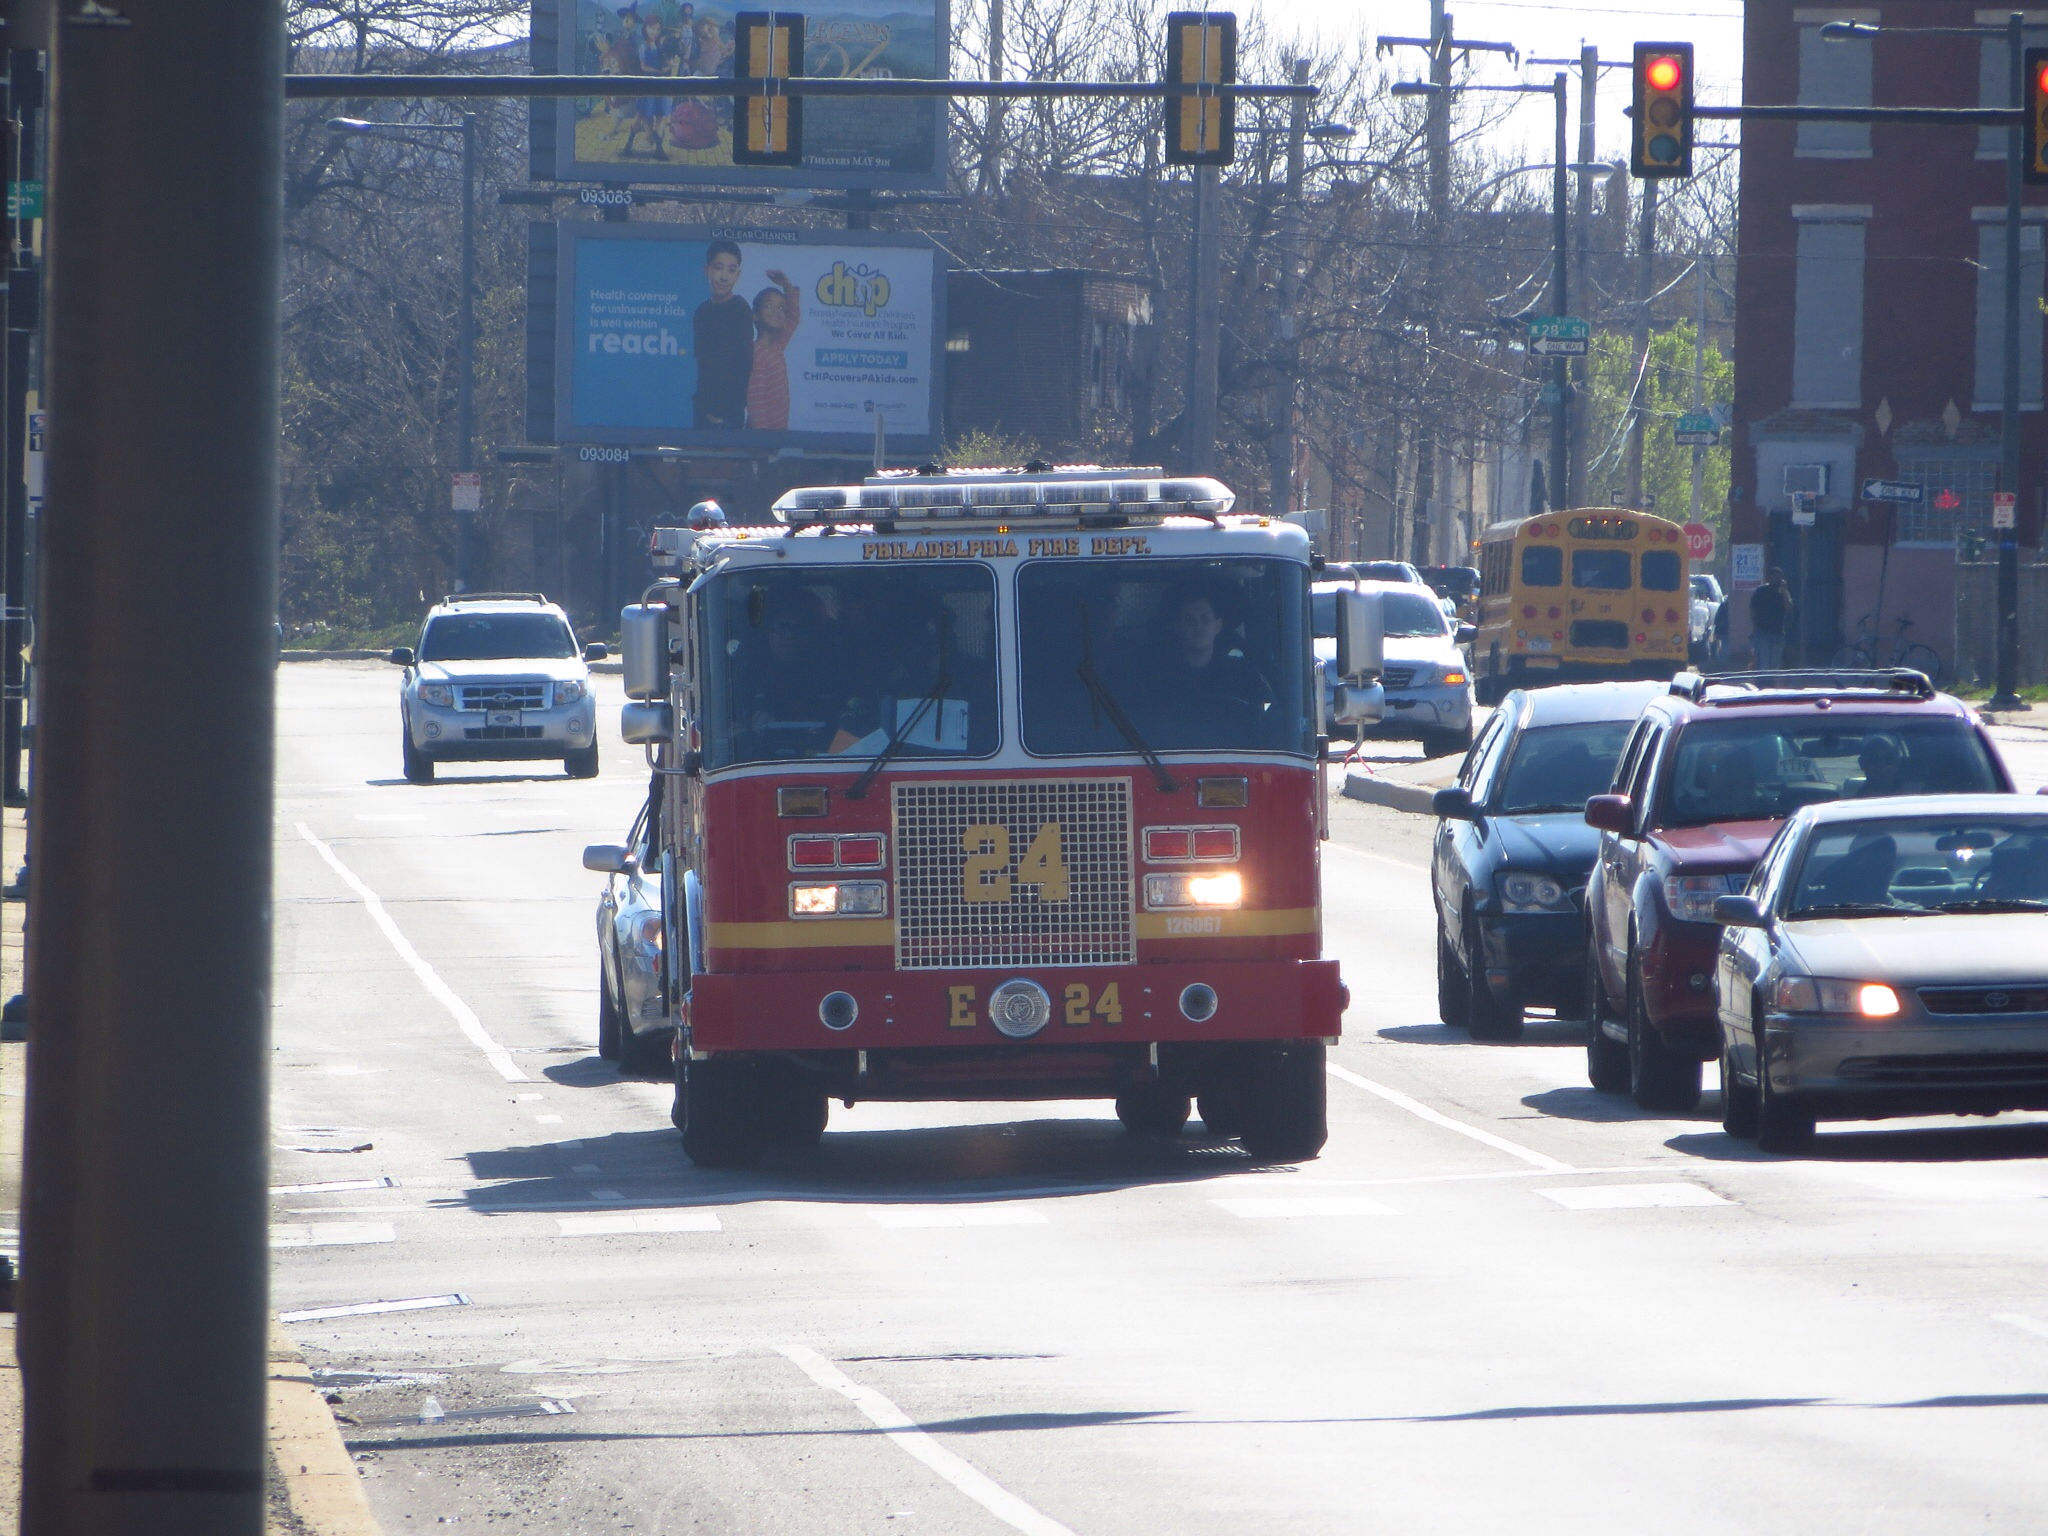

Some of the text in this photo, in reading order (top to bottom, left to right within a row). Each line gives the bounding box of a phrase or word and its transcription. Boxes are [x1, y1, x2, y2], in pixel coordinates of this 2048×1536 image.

[808, 155, 850, 166] THEATERS
[852, 156, 873, 166] MAY
[875, 158, 891, 167] 9TH
[590, 289, 679, 304] Health coverage
[591, 303, 686, 316] for uninsured kids
[601, 317, 621, 328] well
[623, 317, 658, 328] within
[831, 330, 845, 339] We
[847, 330, 872, 339] Cover
[873, 330, 885, 339] All
[1542, 325, 1566, 337] 28th
[1572, 326, 1586, 337] St
[588, 327, 688, 356] reach.
[1547, 342, 1581, 351] ONE WAY
[821, 353, 859, 364] APPLY
[579, 447, 630, 462] 093084
[1881, 486, 1897, 496] ONE
[862, 535, 1153, 560] PHILADELPHIA FIRE DEPT.
[1686, 534, 1711, 550] TOP
[963, 823, 1068, 902] 24
[1166, 916, 1222, 934] 126067
[947, 981, 1123, 1028] E 24
